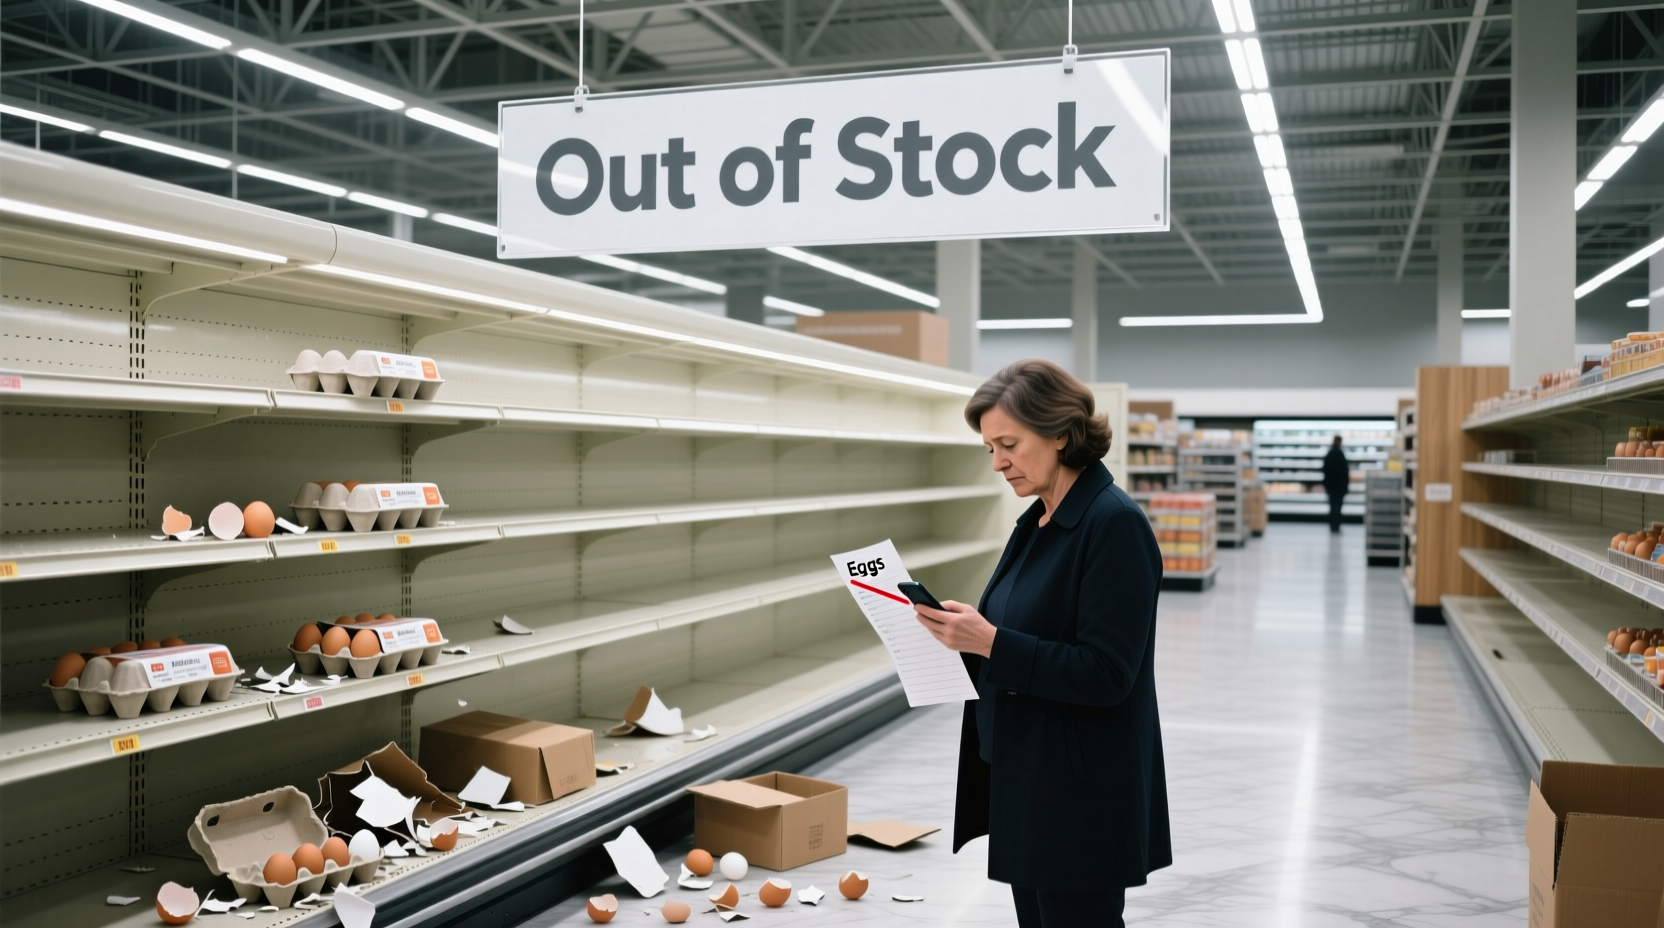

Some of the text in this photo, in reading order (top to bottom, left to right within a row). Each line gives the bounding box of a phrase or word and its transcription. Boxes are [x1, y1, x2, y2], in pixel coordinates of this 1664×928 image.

[535, 101, 1118, 216] Out of Stock
[847, 557, 885, 577] Eggs
